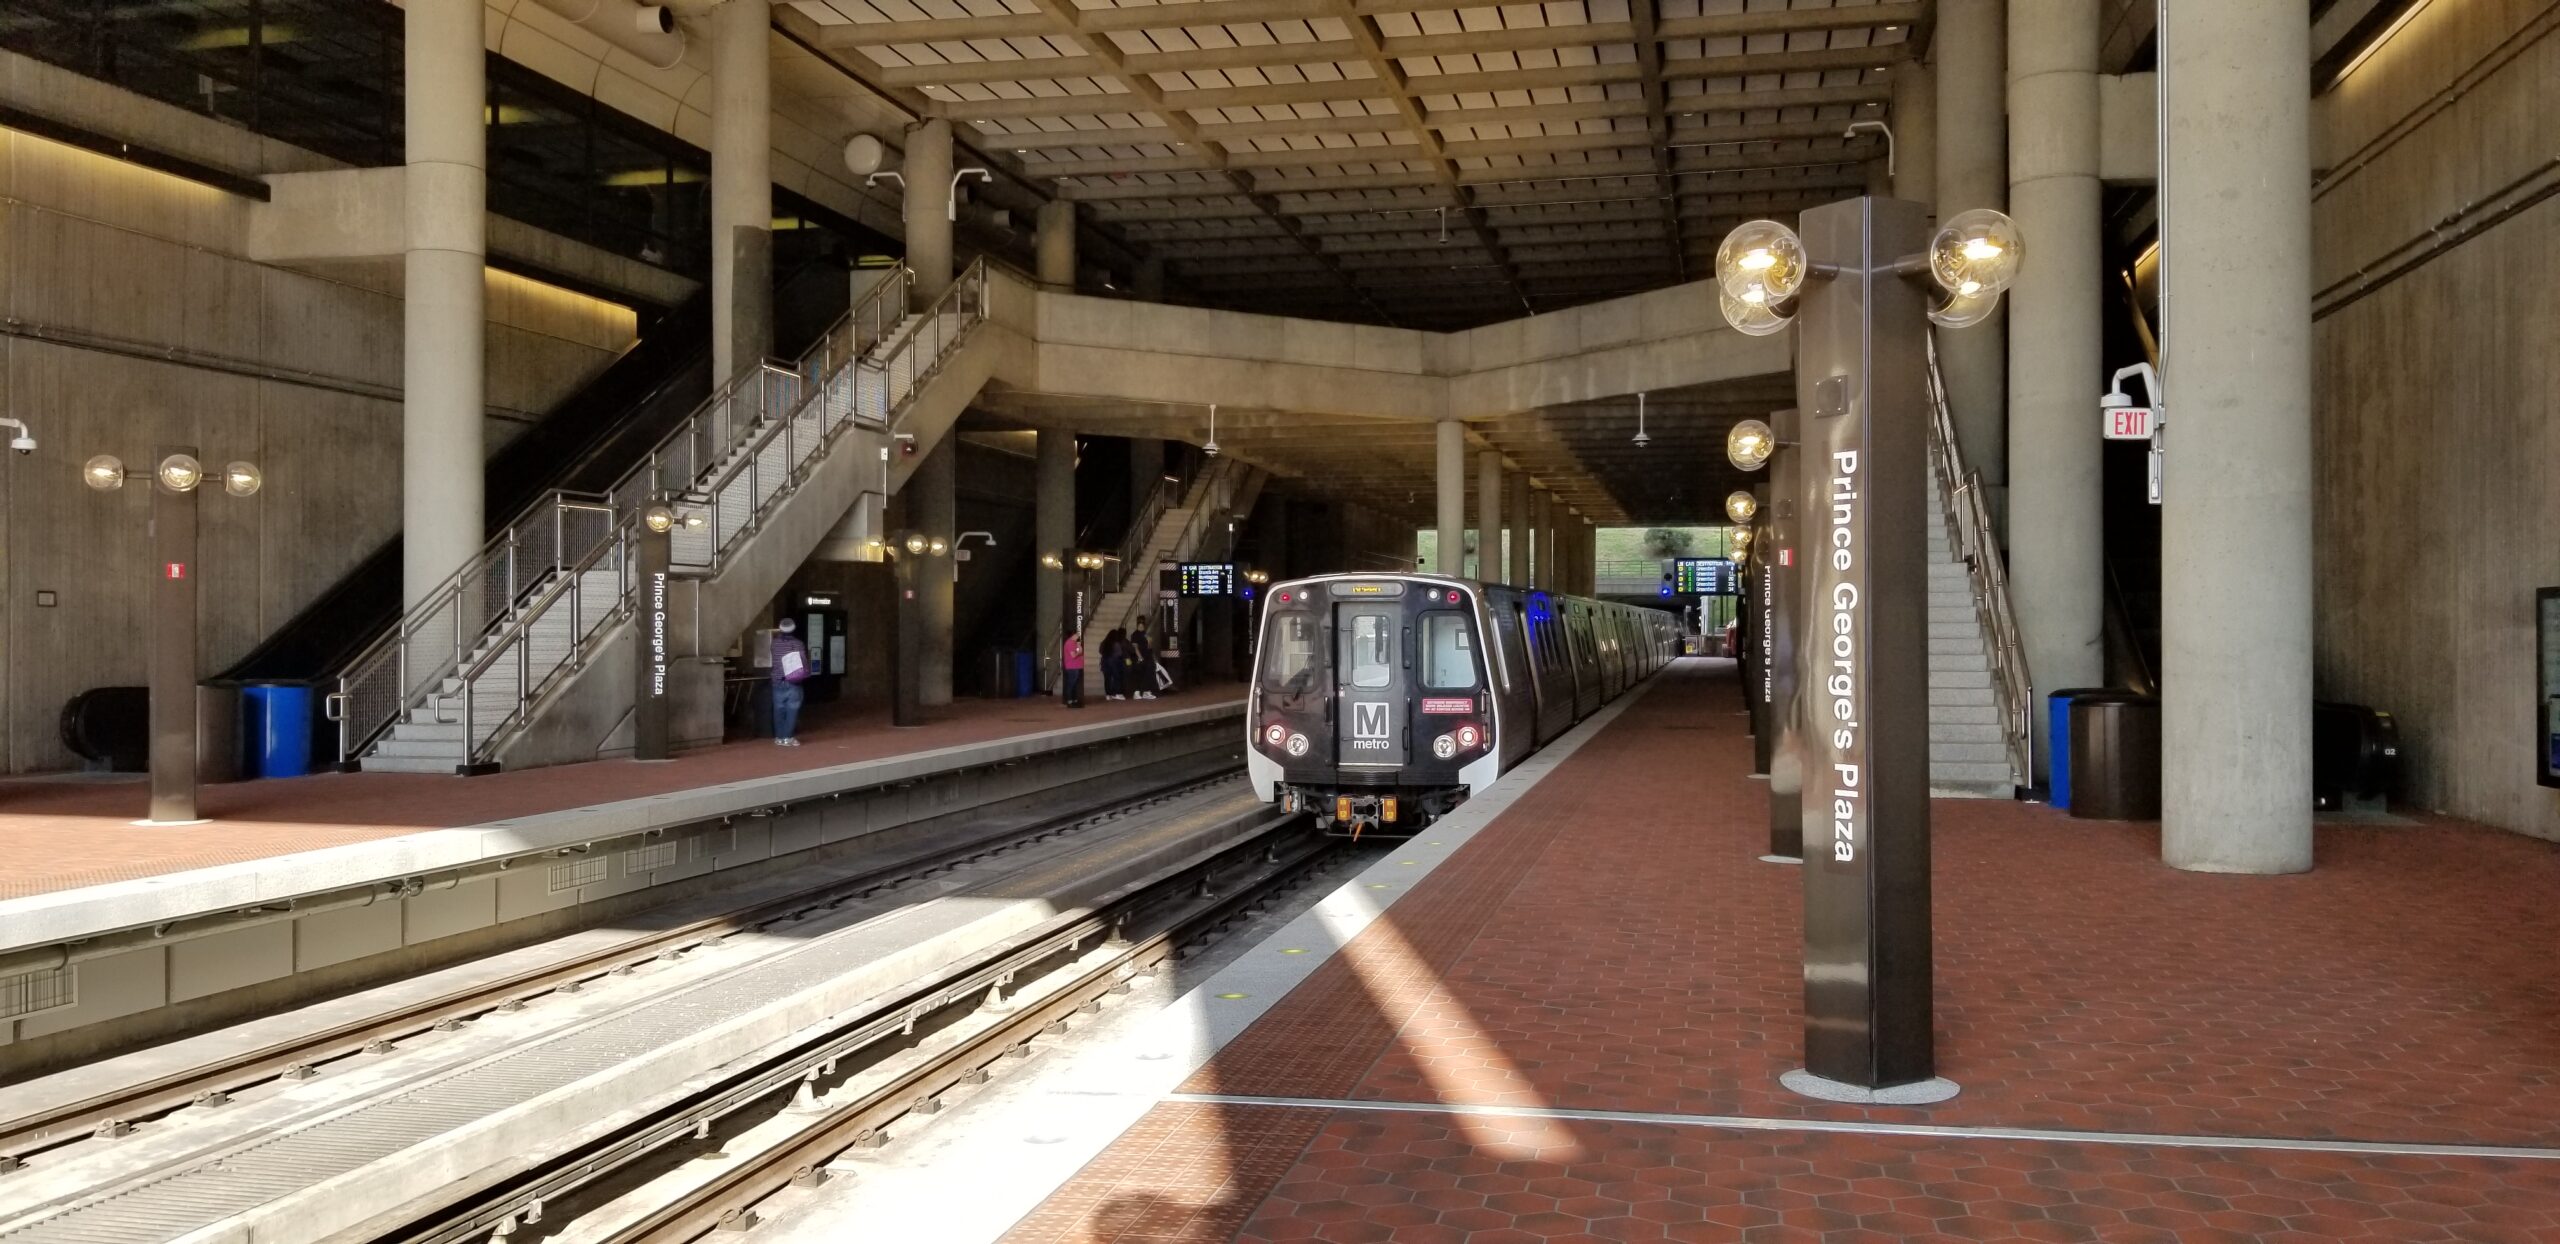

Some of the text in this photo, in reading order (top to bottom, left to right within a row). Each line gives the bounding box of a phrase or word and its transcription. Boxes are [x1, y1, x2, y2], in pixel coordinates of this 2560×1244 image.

[2114, 412, 2147, 435] EXIT
[652, 573, 666, 694] Prince George's Plaza
[1828, 450, 1859, 862] Prince George's Plaza
[1356, 704, 1386, 736] M
[1354, 739, 1389, 749] metro
